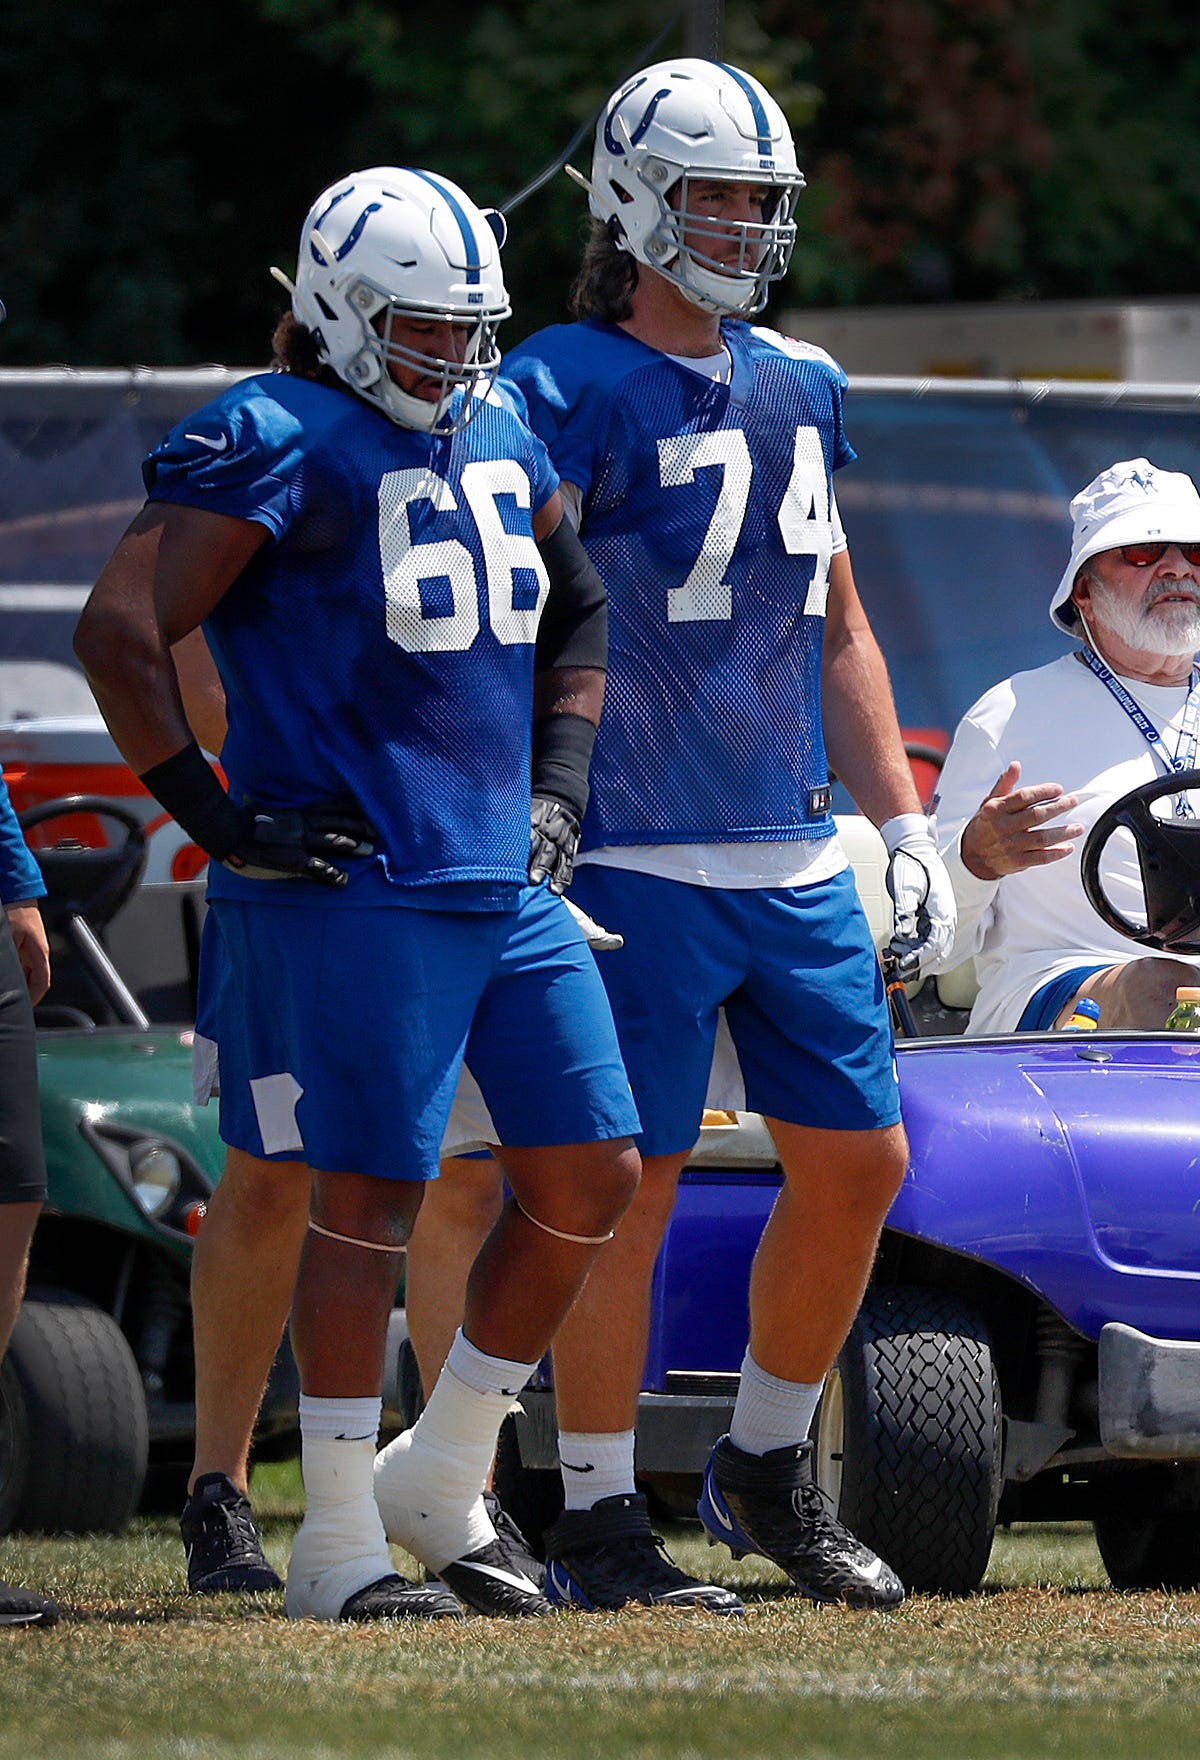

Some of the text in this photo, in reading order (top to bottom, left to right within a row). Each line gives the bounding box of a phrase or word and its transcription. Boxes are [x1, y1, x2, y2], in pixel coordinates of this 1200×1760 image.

[377, 459, 551, 653] 66
[656, 425, 832, 622] 74
[1132, 712, 1150, 730] COLTS
